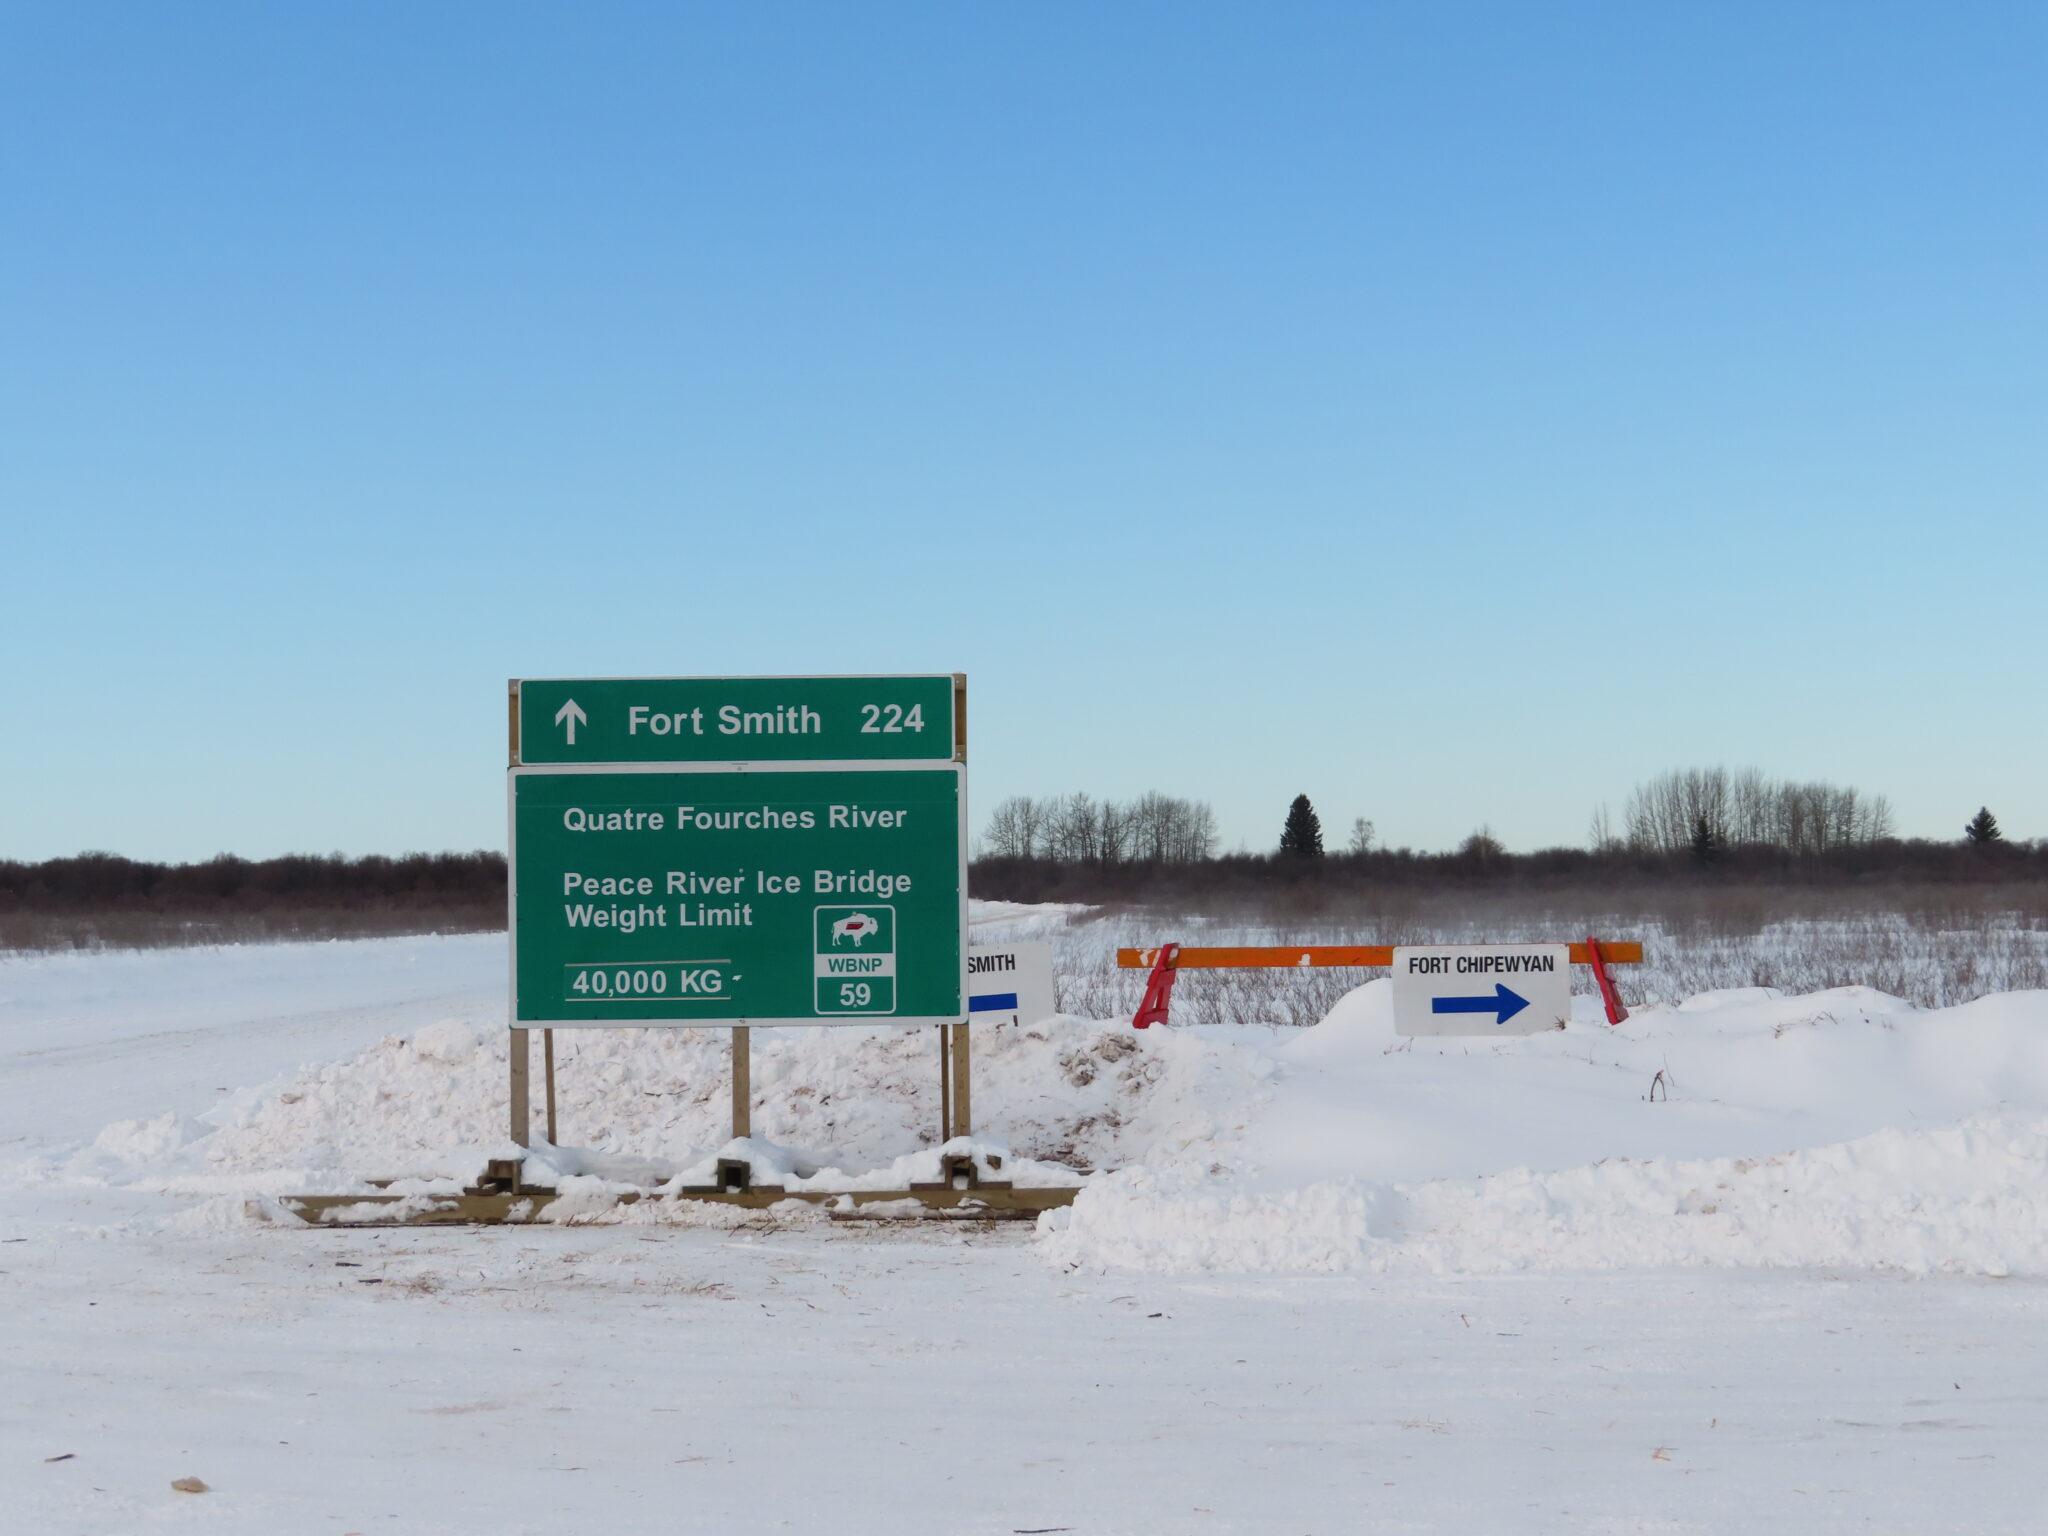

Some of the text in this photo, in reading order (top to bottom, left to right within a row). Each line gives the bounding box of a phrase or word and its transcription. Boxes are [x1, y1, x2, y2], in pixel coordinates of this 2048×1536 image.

[628, 704, 925, 735] Fort Smith 224
[564, 805, 907, 832] Quatre Fourches River
[564, 869, 912, 898] Peace River Ice Bridge
[565, 903, 753, 932] Weight Limit
[828, 958, 882, 972] WBNP
[968, 954, 1016, 973] SMITH
[1409, 955, 1554, 974] FORT CHIPEWYAN
[572, 969, 722, 997] 40,000 KG
[840, 982, 871, 1006] 59
